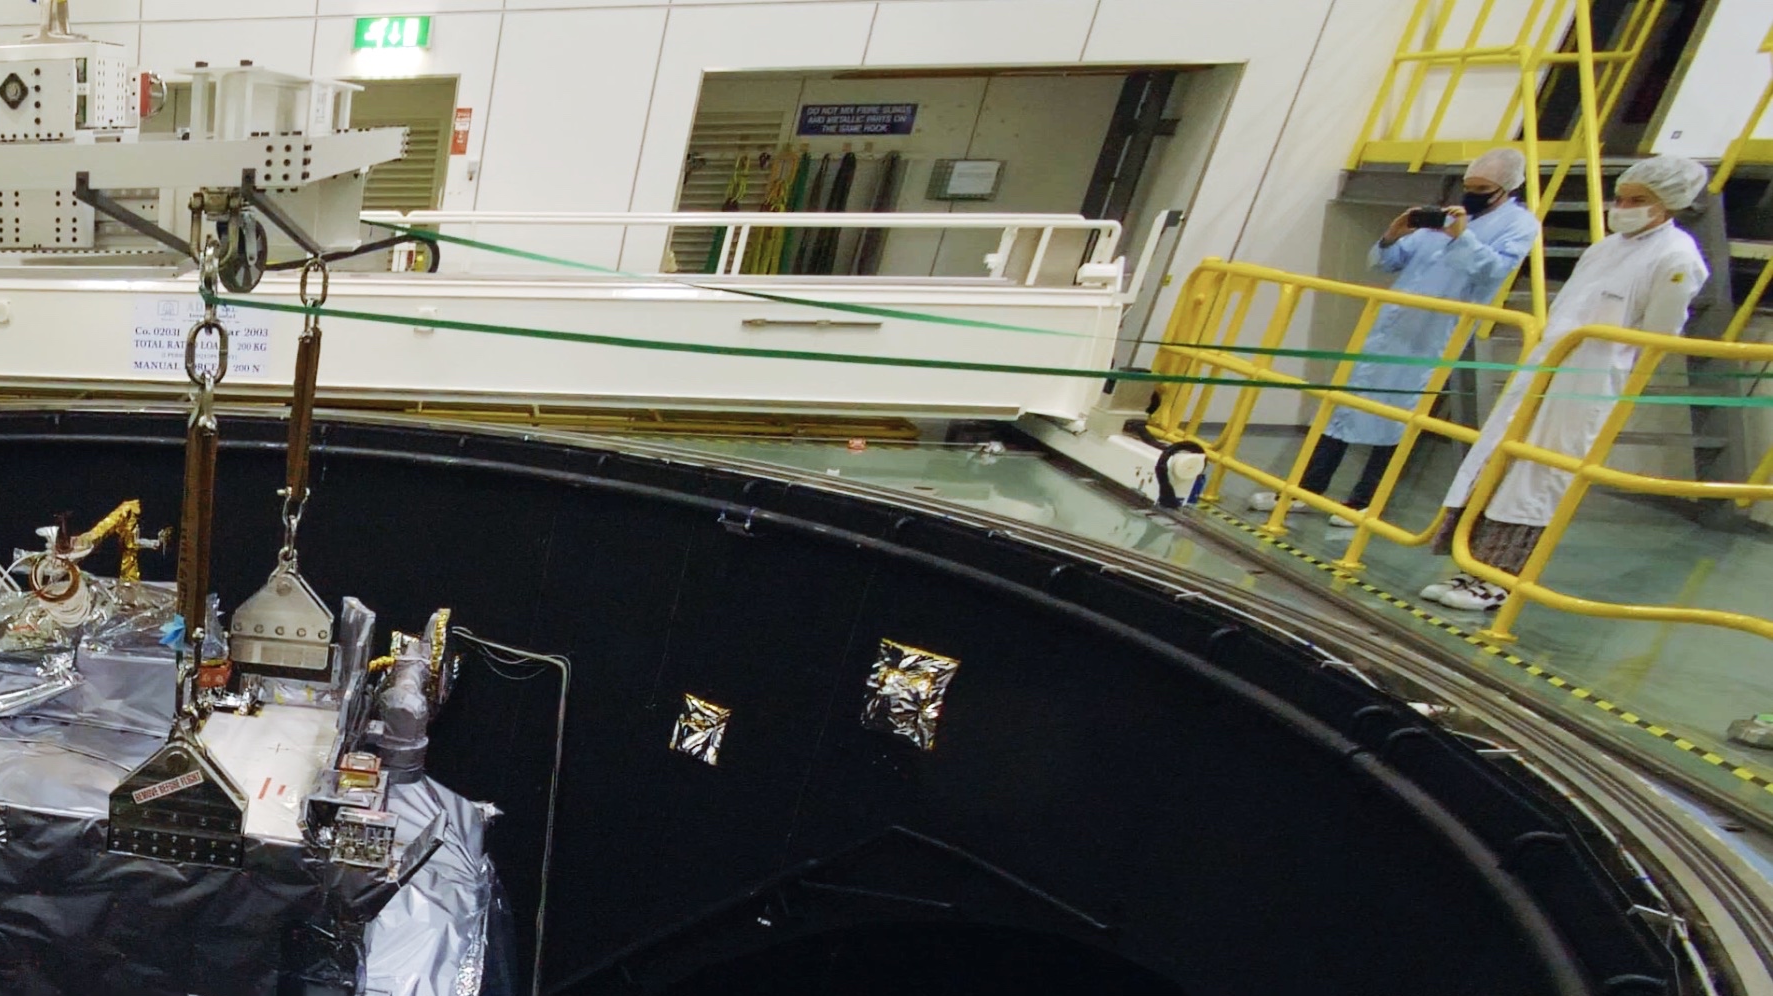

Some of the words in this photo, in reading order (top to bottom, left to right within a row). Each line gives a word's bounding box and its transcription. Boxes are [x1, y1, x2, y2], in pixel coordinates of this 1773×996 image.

[806, 107, 819, 115] DO
[821, 107, 837, 115] NOT
[807, 115, 825, 124] AND
[826, 115, 864, 123] METALLIC
[866, 115, 891, 123] PARTS
[893, 115, 907, 123] ON
[821, 124, 837, 132] THE
[838, 124, 862, 132] SAME
[135, 326, 151, 335] Co.
[153, 328, 180, 336] 02031
[243, 328, 268, 337] 2003
[134, 339, 164, 348] TOTAL
[200, 341, 219, 350] LOA
[253, 342, 267, 351] KG
[134, 361, 178, 370] MANUAL
